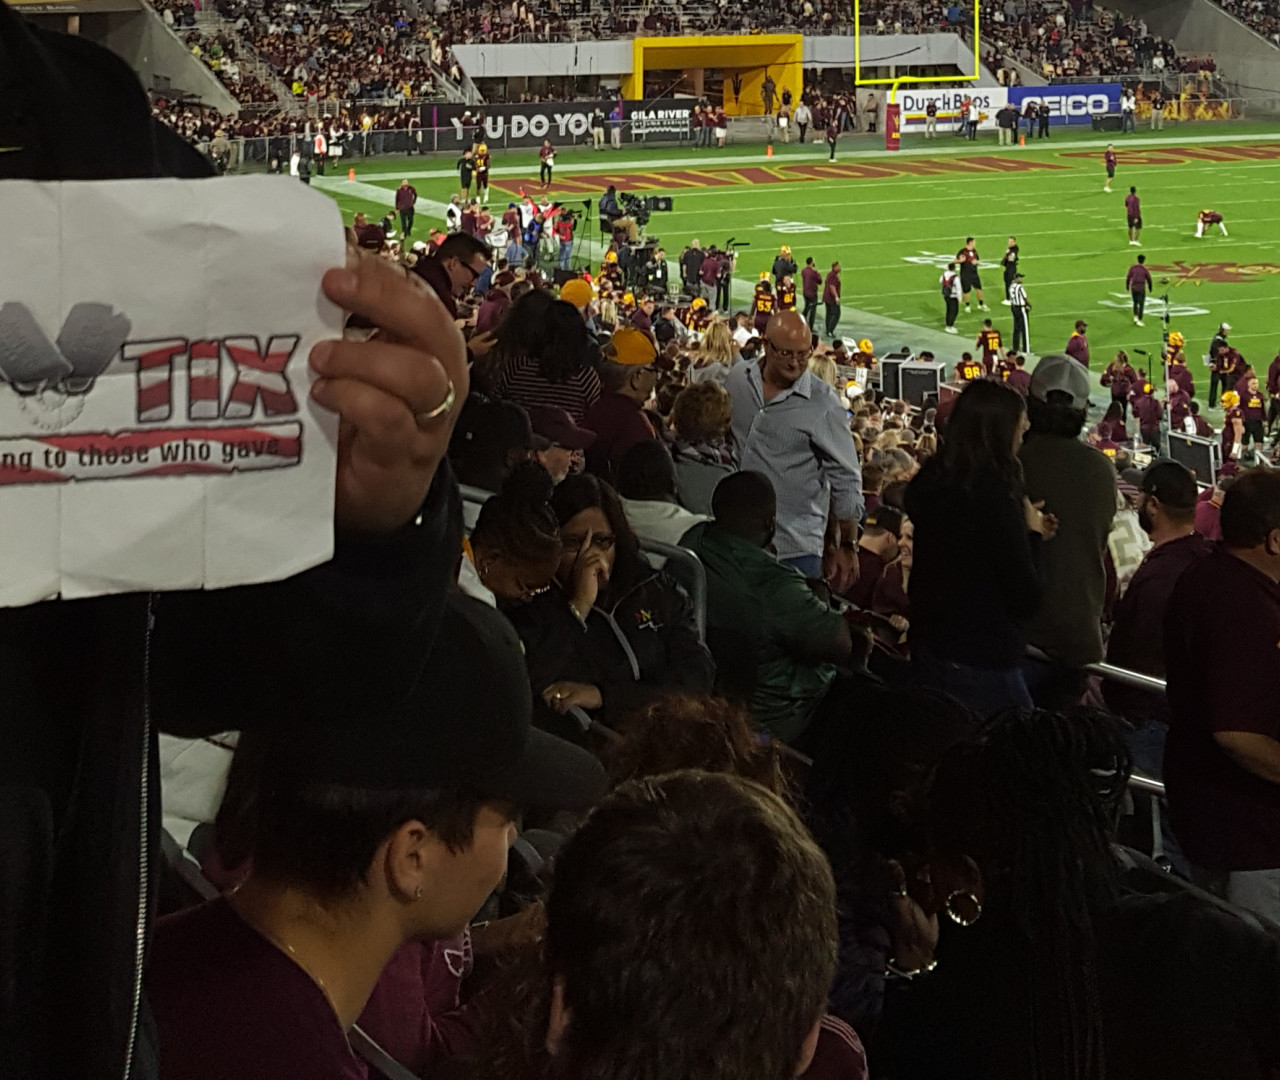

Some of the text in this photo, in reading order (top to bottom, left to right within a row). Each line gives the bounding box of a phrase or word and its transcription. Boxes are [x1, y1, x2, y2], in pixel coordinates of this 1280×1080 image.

[451, 116, 504, 140] YU
[511, 115, 550, 138] DO
[631, 109, 691, 120] GILA RIVER
[120, 335, 302, 424] TIX
[43, 447, 67, 468] to
[77, 442, 148, 466] those
[160, 439, 210, 462] who
[222, 438, 279, 463] gave
